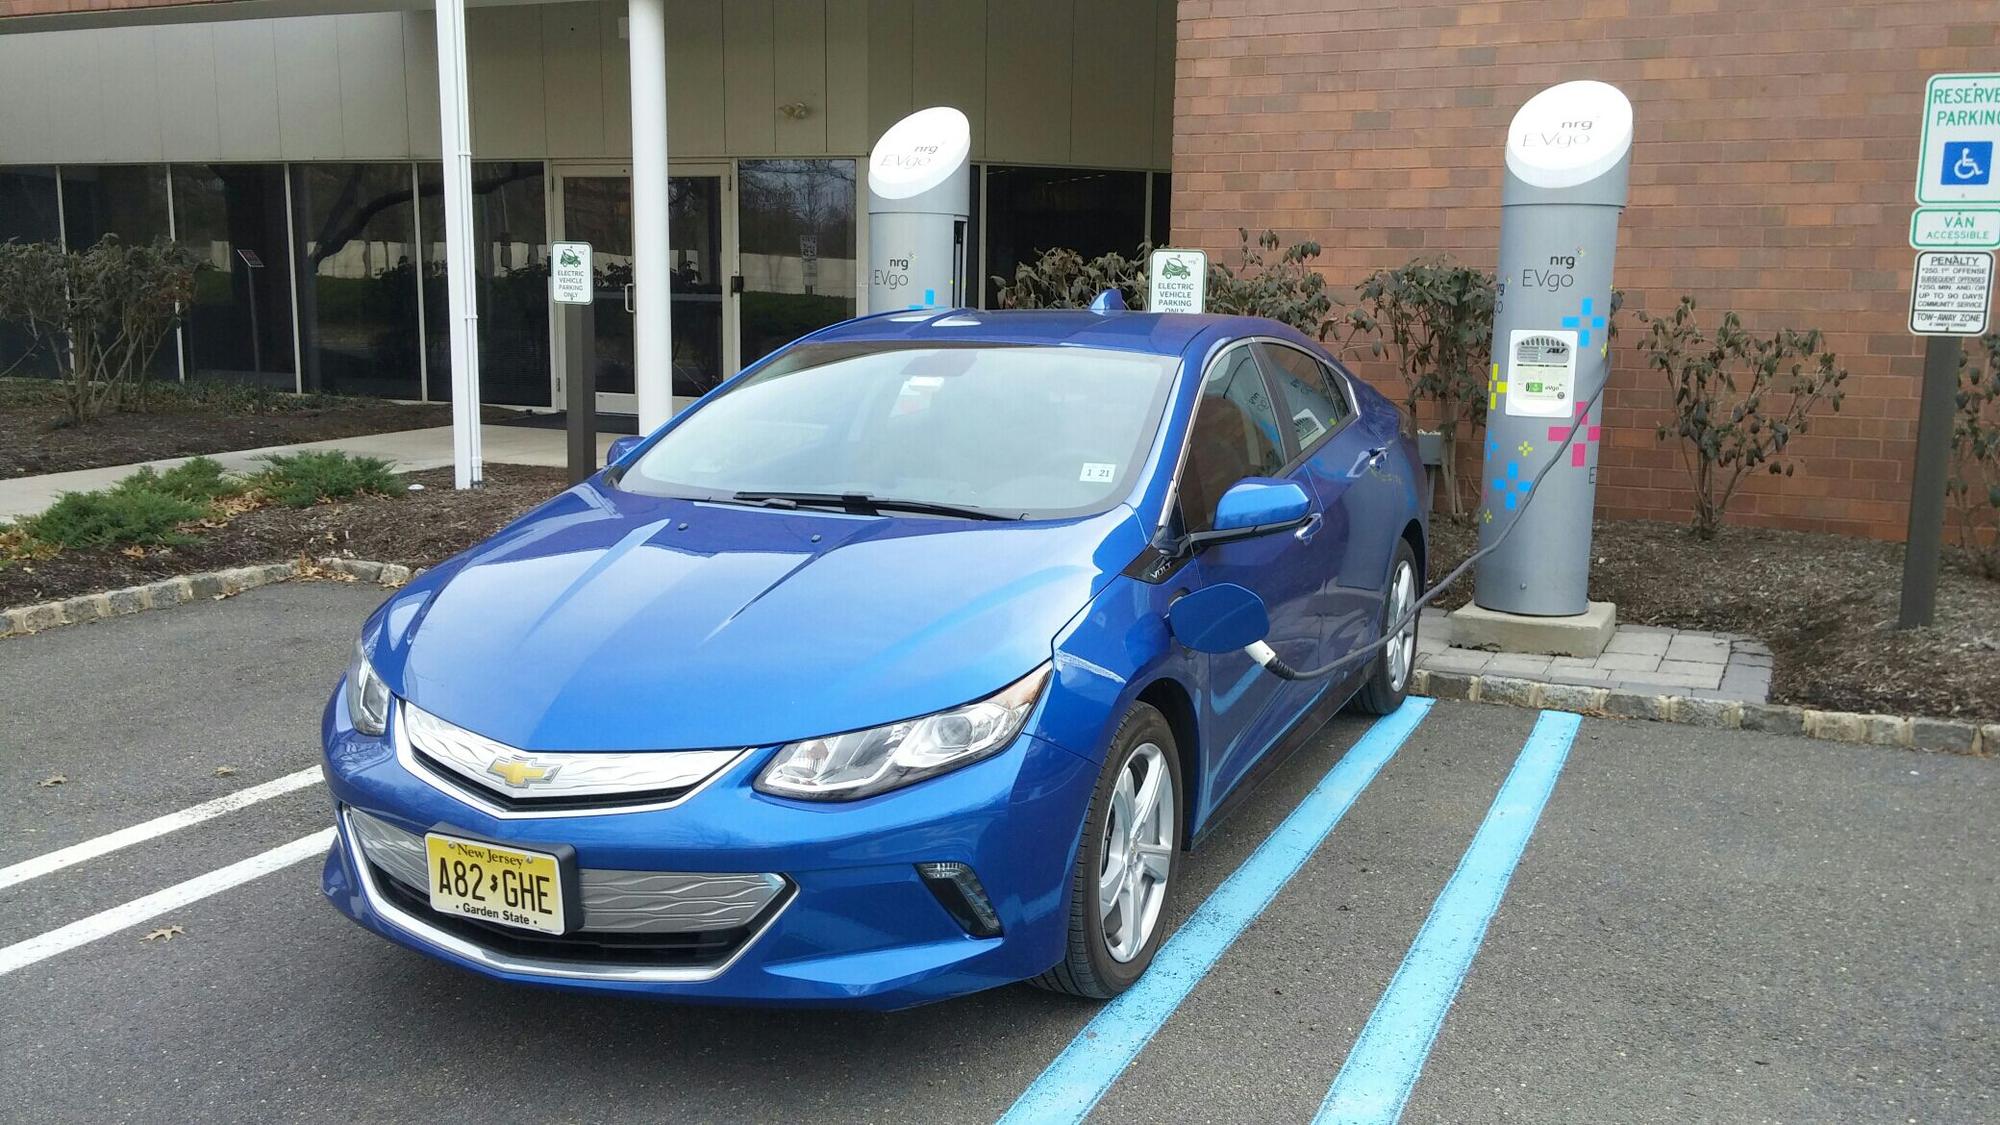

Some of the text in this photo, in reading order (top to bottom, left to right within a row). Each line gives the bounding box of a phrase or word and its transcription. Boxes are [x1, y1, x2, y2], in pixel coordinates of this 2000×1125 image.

[1933, 87, 2000, 104] RESERVE
[1560, 120, 1593, 131] nrg
[1522, 131, 1591, 149] EVgo
[914, 145, 938, 155] nrg
[880, 153, 932, 170] EVgo
[1944, 215, 1975, 228] VAN
[1926, 230, 1989, 239] ACCESSIBLE
[889, 258, 909, 271] nrg
[1550, 255, 1576, 270] nrg
[1931, 256, 1979, 266] PENALTY
[1953, 267, 1986, 275] OFFENSE
[874, 269, 909, 290] EVgo
[1158, 282, 1194, 290] ELECTRIC
[1522, 269, 1574, 292] EVgo
[1158, 299, 1192, 307] PARKING
[1917, 312, 1982, 322] TOW-AWAY ZONE
[1098, 469, 1110, 477] 21
[1150, 560, 1172, 579] VOLT
[456, 842, 524, 869] New Jersey
[439, 857, 553, 915] A82 GHE
[462, 902, 530, 925] Garden State
